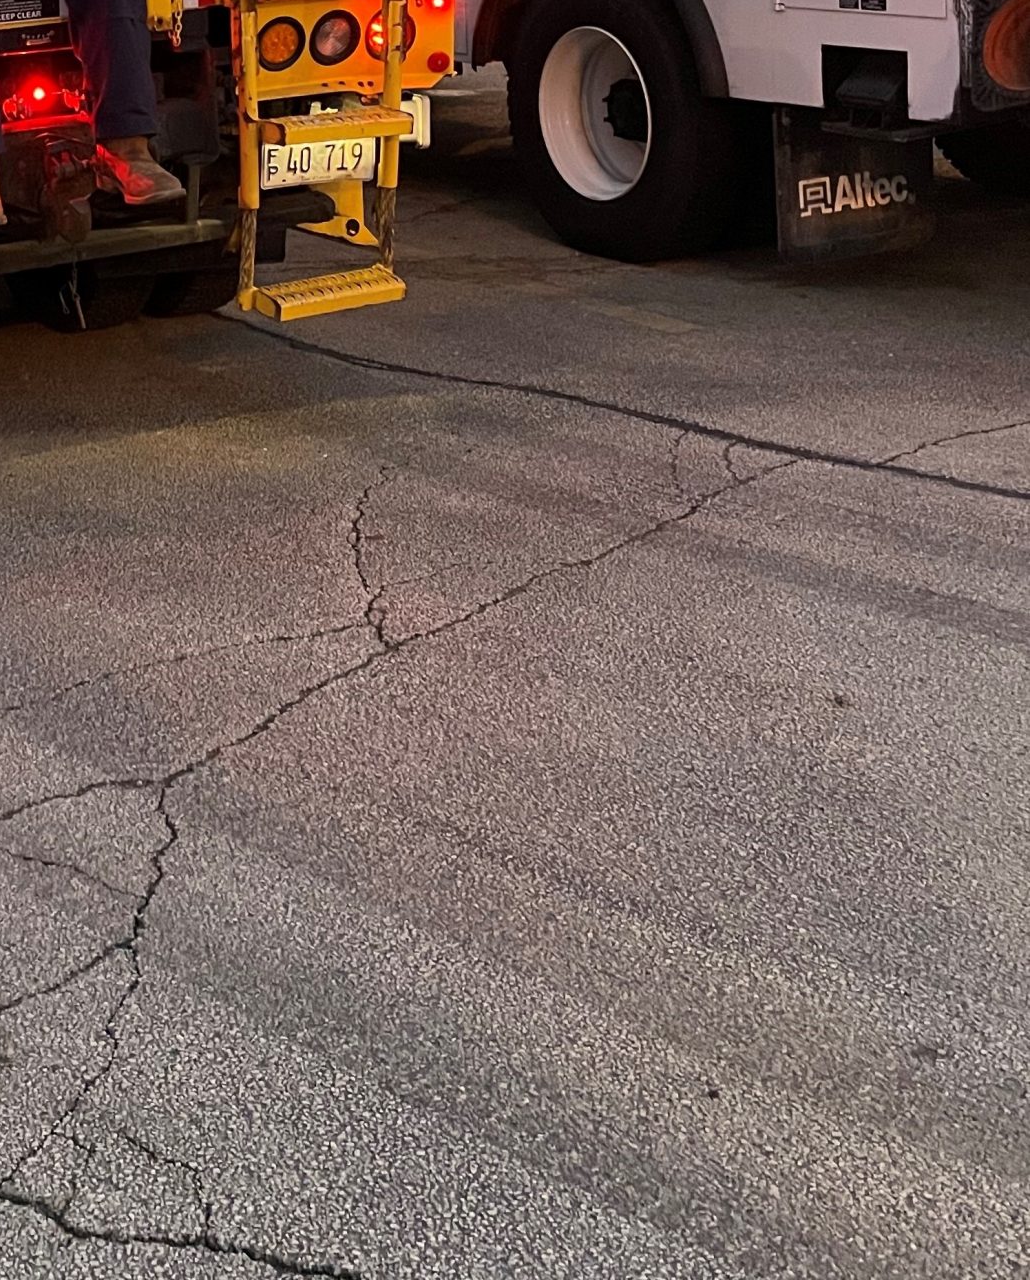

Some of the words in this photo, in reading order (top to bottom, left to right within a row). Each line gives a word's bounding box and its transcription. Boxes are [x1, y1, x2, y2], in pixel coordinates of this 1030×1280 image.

[16, 10, 42, 20] CLEAR
[325, 142, 363, 172] 719
[834, 171, 908, 212] Altec
